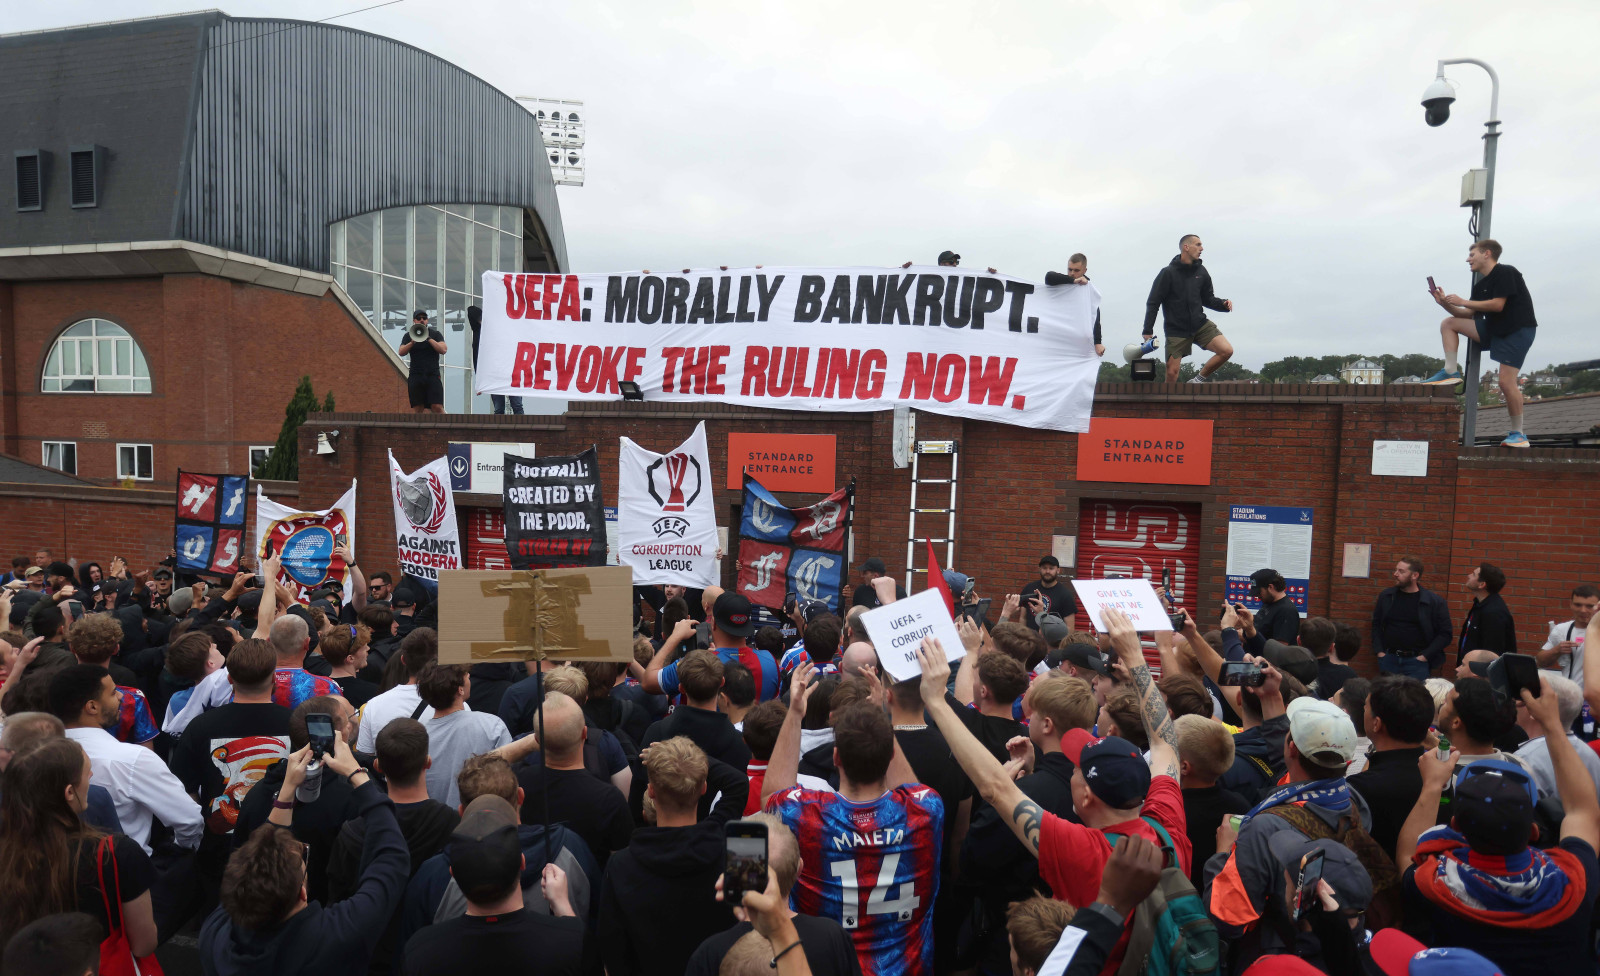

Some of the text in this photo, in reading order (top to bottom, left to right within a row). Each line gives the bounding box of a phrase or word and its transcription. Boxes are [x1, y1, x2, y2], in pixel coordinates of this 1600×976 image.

[503, 273, 1039, 334] UEFA: MORALLY BANKRUPT.
[661, 345, 731, 396] THE
[740, 345, 887, 400] RULING
[898, 351, 1026, 411] NOW.
[1104, 439, 1185, 450] STANDARD
[748, 452, 814, 462] STANDARD
[1103, 452, 1185, 464] ENTRANCE
[476, 462, 505, 472] Entranc
[514, 460, 589, 478] FOOTBALL:
[748, 464, 814, 475] ENTRANCE
[508, 483, 596, 504] CREATED BY
[518, 511, 544, 531] THE
[547, 511, 591, 532] POOR,
[1232, 513, 1267, 521] REGULATIONS
[653, 519, 687, 536] UEFA
[399, 533, 456, 555] AGAINST
[518, 538, 592, 556] STOLEN BY
[631, 544, 703, 557] CORRUPTION
[399, 548, 458, 570] MODERN
[401, 562, 438, 580] FOOTB
[1096, 590, 1133, 598] GIVE US
[1097, 601, 1144, 610] WHAT WE
[891, 624, 934, 648] CORRUPT
[830, 853, 920, 929] 14
